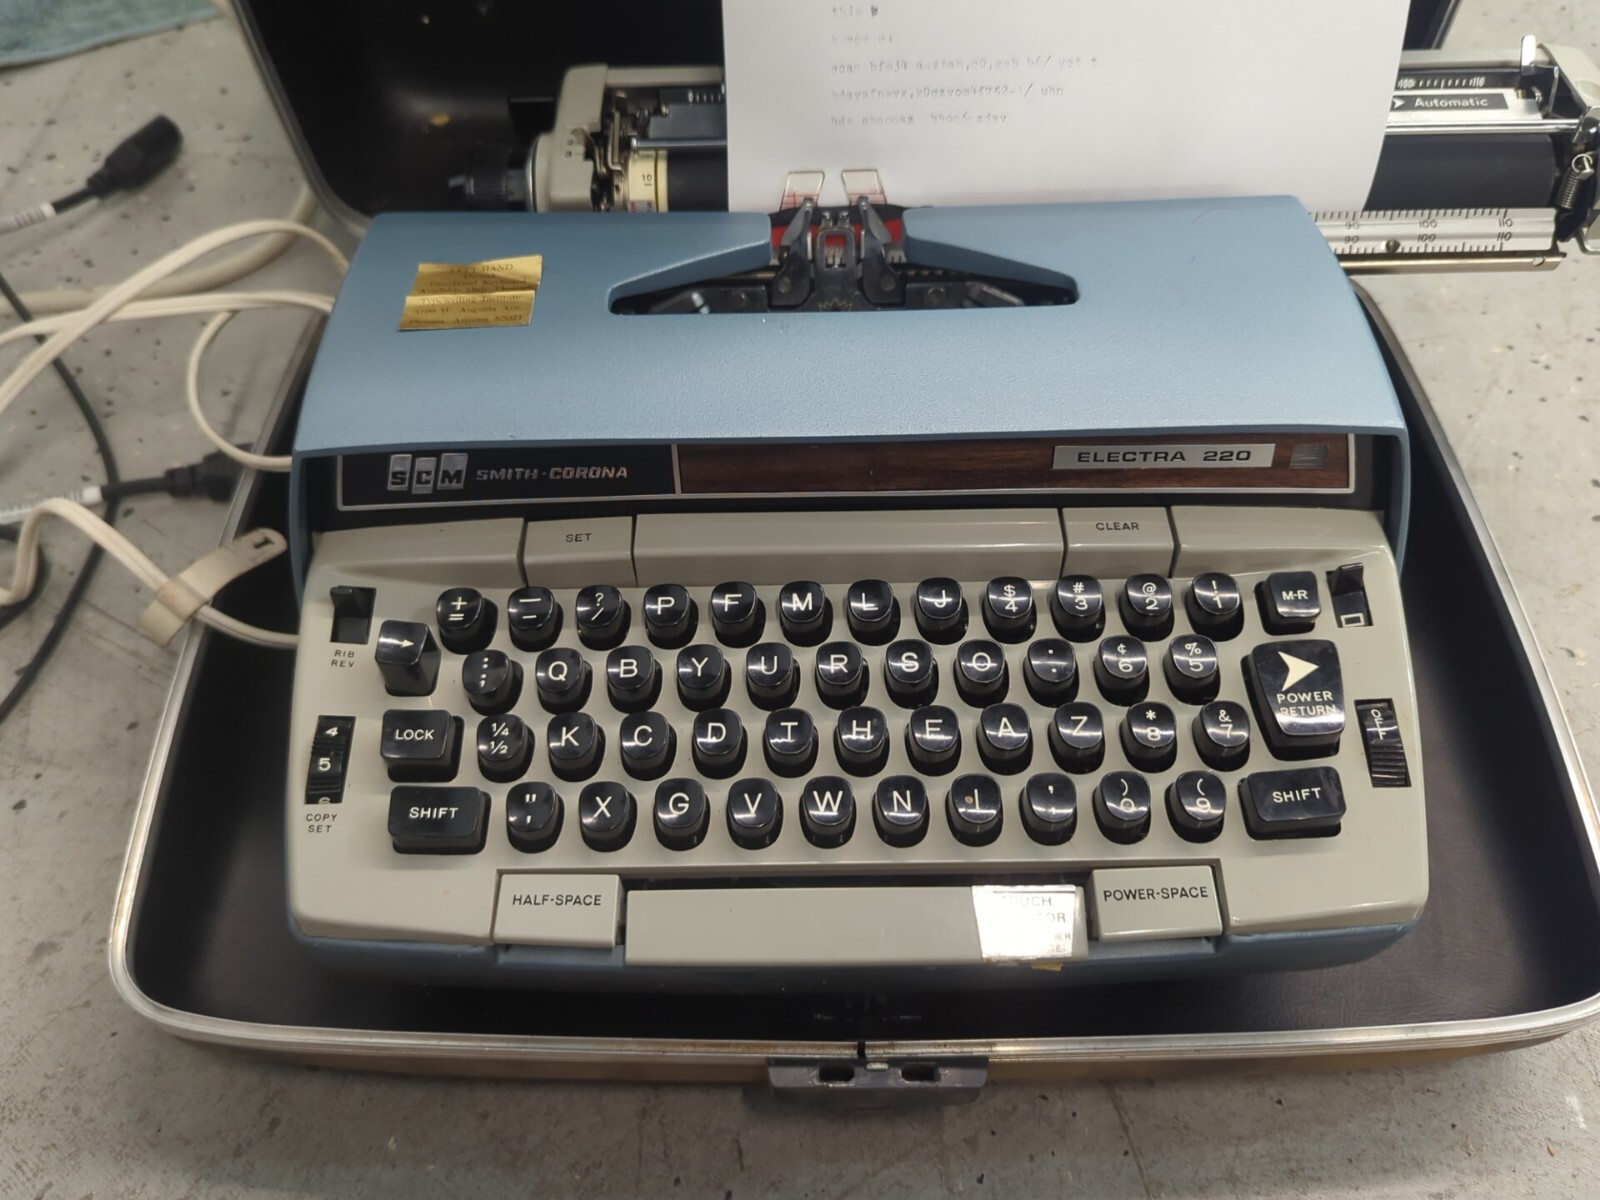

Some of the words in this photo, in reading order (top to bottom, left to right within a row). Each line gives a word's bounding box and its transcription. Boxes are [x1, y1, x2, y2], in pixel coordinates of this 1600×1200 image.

[1414, 97, 1488, 108] Automatic
[642, 174, 652, 182] 10
[1419, 219, 1438, 228] 100
[1498, 218, 1513, 228] 110
[1344, 236, 1359, 244] 90
[1417, 233, 1436, 242] 100
[1497, 232, 1512, 241] 110
[482, 264, 513, 272] HAND
[1077, 451, 1186, 463] ELECTRA
[1202, 451, 1251, 462] 220
[1096, 522, 1139, 531] CLEAR
[566, 532, 592, 543] SET
[724, 593, 742, 612] F
[792, 593, 813, 611] M
[861, 592, 878, 611] L
[933, 590, 946, 608] J
[1282, 590, 1308, 601] M-R
[656, 597, 675, 614] P
[1005, 599, 1018, 612] 4
[1075, 597, 1089, 611] 3
[1146, 598, 1159, 611] 2
[334, 650, 355, 658] RIB
[331, 659, 356, 668] REV
[619, 659, 638, 677] B
[691, 657, 709, 676] Y
[761, 656, 777, 674] U
[830, 654, 849, 673] R
[900, 653, 920, 672] S
[1119, 658, 1133, 672] 6
[1190, 658, 1203, 672] 5
[548, 661, 568, 681] Q
[1276, 691, 1333, 702] POWER
[1280, 704, 1336, 716] RETURN
[780, 722, 798, 741] T
[853, 720, 871, 739] H
[925, 719, 942, 738] E
[998, 717, 1015, 736] A
[1070, 716, 1088, 735] Z
[1220, 724, 1233, 738] 7
[1371, 710, 1386, 739] OFF
[325, 727, 339, 737] 4
[395, 729, 434, 740] LOCK
[560, 726, 579, 746] K
[634, 726, 652, 746] C
[707, 723, 726, 742] D
[1147, 727, 1161, 740] 8
[318, 758, 331, 771] 5
[813, 790, 843, 813] W
[893, 790, 911, 812] N
[1272, 788, 1321, 803] SHIFT
[594, 797, 613, 817] X
[669, 792, 690, 815] G
[744, 793, 762, 814] V
[1197, 798, 1211, 812] 9
[306, 813, 338, 822] COPY
[409, 807, 459, 819] SHIFT
[308, 824, 333, 833] SET
[511, 894, 602, 907] HALF-SPACE
[1102, 886, 1209, 902] POWER-SPACE
